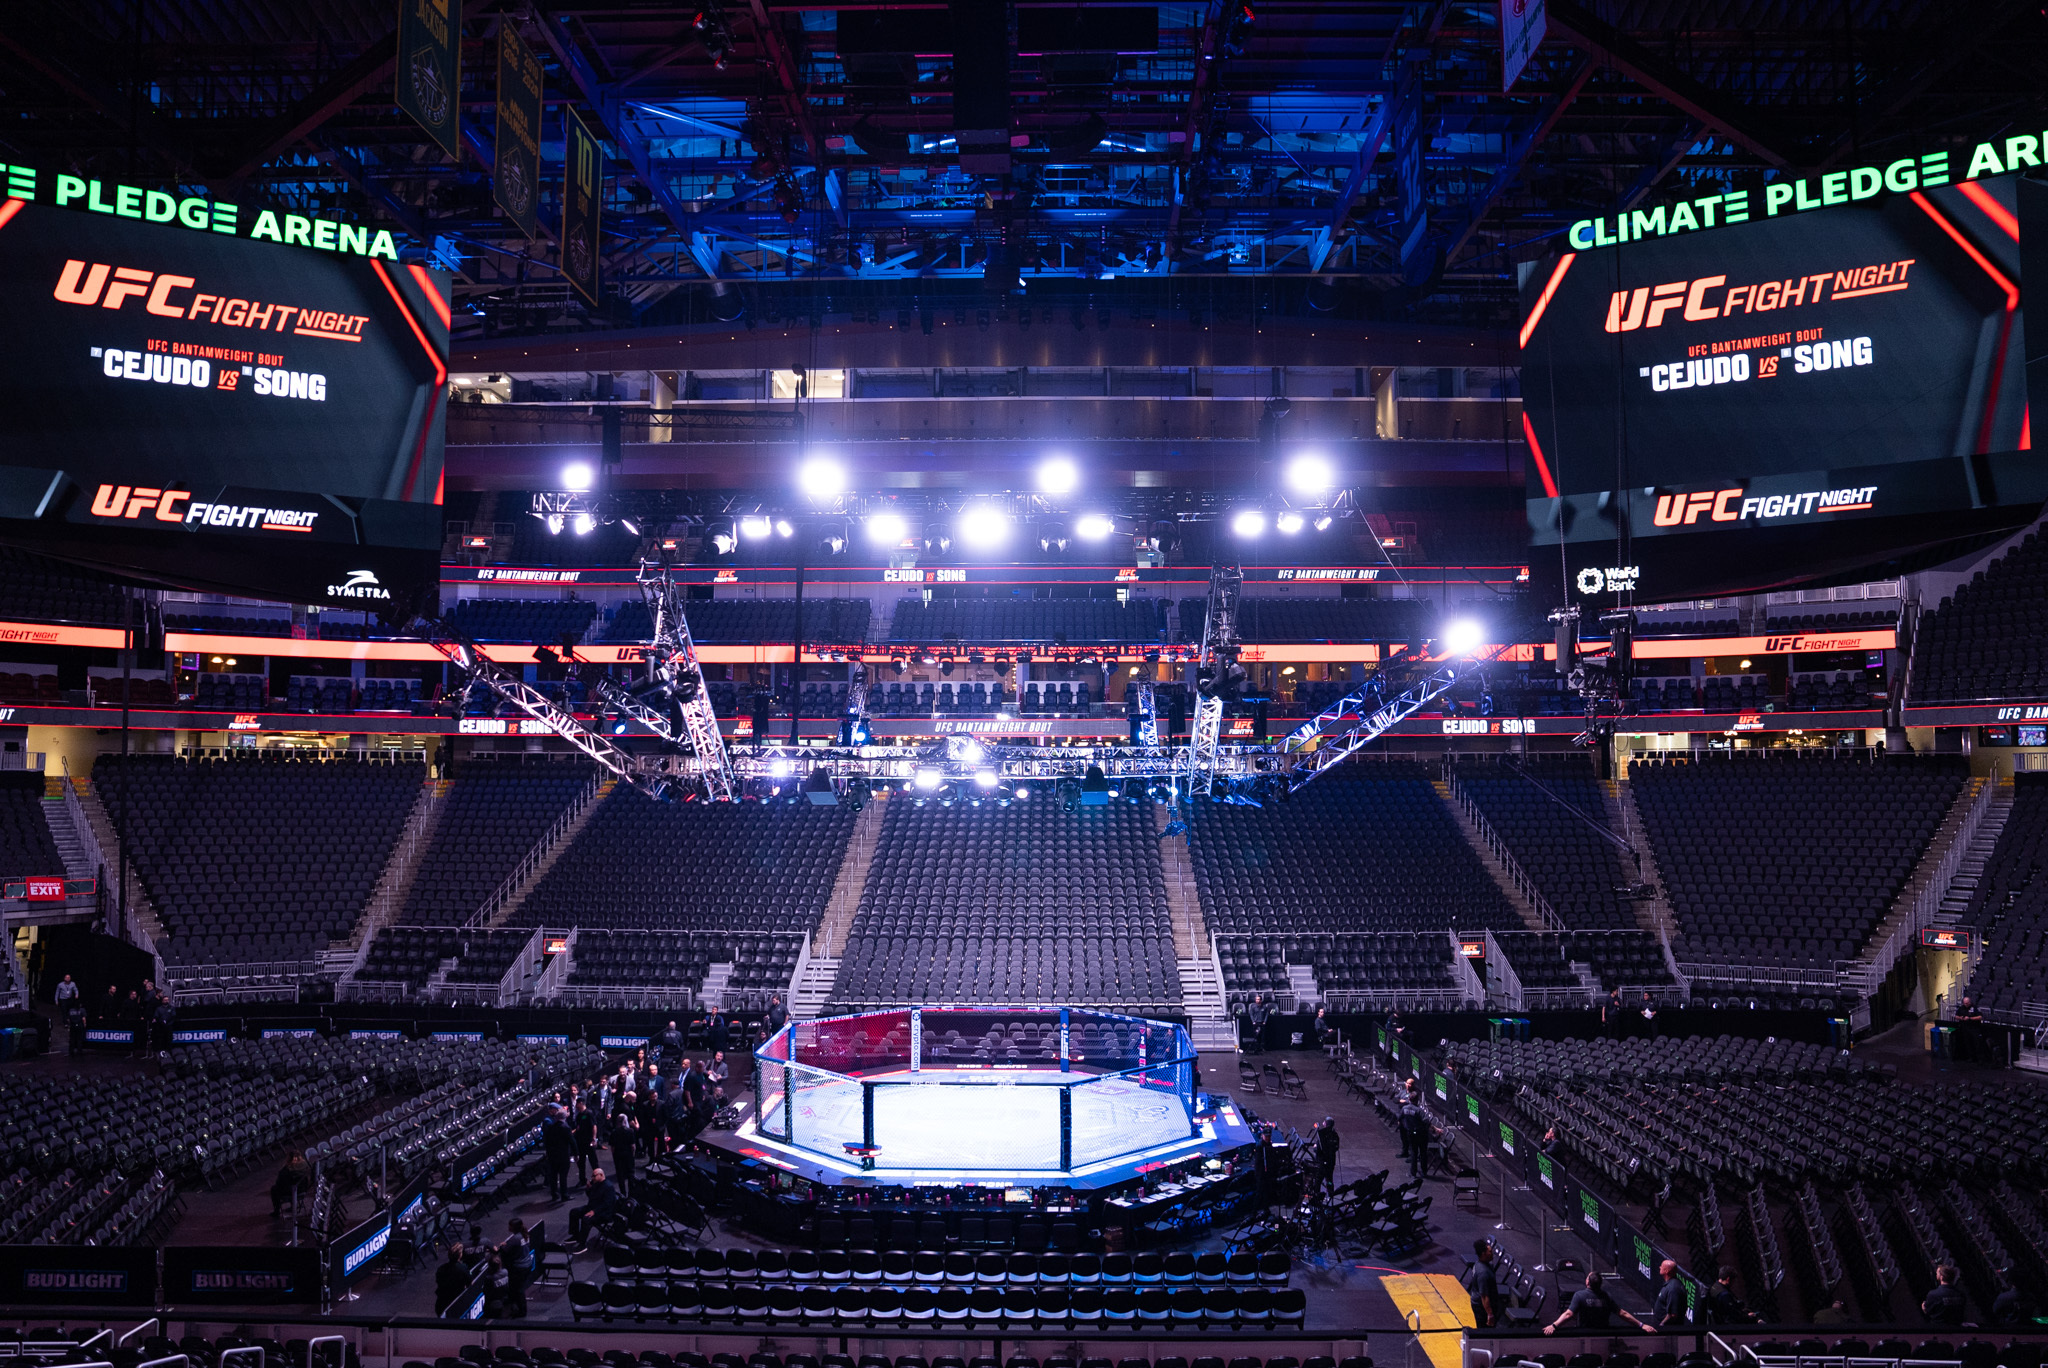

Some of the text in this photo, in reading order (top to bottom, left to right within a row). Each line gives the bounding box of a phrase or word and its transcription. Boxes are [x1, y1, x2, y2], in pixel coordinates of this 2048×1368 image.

[575, 126, 594, 200] 10
[1568, 129, 2048, 251] CLIMATE PLEDGE AR
[56, 173, 239, 235] PLEDGE
[250, 210, 399, 261] ARENA
[53, 259, 370, 335] UFC FIGHT NIGHT
[1604, 259, 1916, 334] UFC FIGHT NIGHT
[1688, 327, 1824, 358] UFC BANTAMWEIGHT BOUT
[147, 338, 284, 367] UFC BANTAMWEIGHT BOUT
[1651, 353, 1750, 392] CEJUDO
[1757, 355, 1779, 378] VS
[1793, 336, 1873, 374] SONG
[103, 348, 211, 388] CEJUDO
[217, 369, 240, 390] VS
[253, 367, 327, 401] SONG
[90, 484, 318, 529] UFC FIGHT NIGHT
[1653, 486, 1878, 527] UFC FIGHT NIGHT
[477, 569, 581, 581] UFC BANTAMWEIGHT BOUT
[717, 570, 736, 578] UFC
[883, 569, 924, 582] CEJUDO
[936, 569, 966, 582] SONG
[1118, 569, 1137, 577] UFC
[1278, 569, 1380, 579] UFC BANTAMWEIGHT BOUT
[1604, 566, 1640, 580] WaFd
[327, 584, 392, 600] SYMETRA
[1605, 578, 1637, 592] Bank
[32, 631, 60, 640] NIGHT
[1765, 637, 1863, 652] UFC FIGHT NIGHT
[617, 648, 641, 661] UF
[234, 715, 258, 724] UFC
[1738, 715, 1761, 725] UFC
[1997, 707, 2022, 720] UFC
[458, 719, 506, 734] CEJUDO
[935, 722, 1054, 733] UFC BANTAMWEIGHT BOUT
[1234, 720, 1255, 729] UFC
[1442, 719, 1489, 734] CEJUDO
[30, 886, 61, 896] EXIT
[1938, 932, 1955, 941] UFC
[86, 1031, 133, 1041] BUD LIGHT
[193, 1031, 225, 1041] LIGHT
[602, 1037, 623, 1047] BUD
[1440, 1038, 1446, 1046] D
[1493, 1069, 1500, 1077] D
[345, 1247, 366, 1272] BUD
[26, 1272, 125, 1289] BUD LIGHT
[195, 1272, 290, 1289] BUD LIGHT
